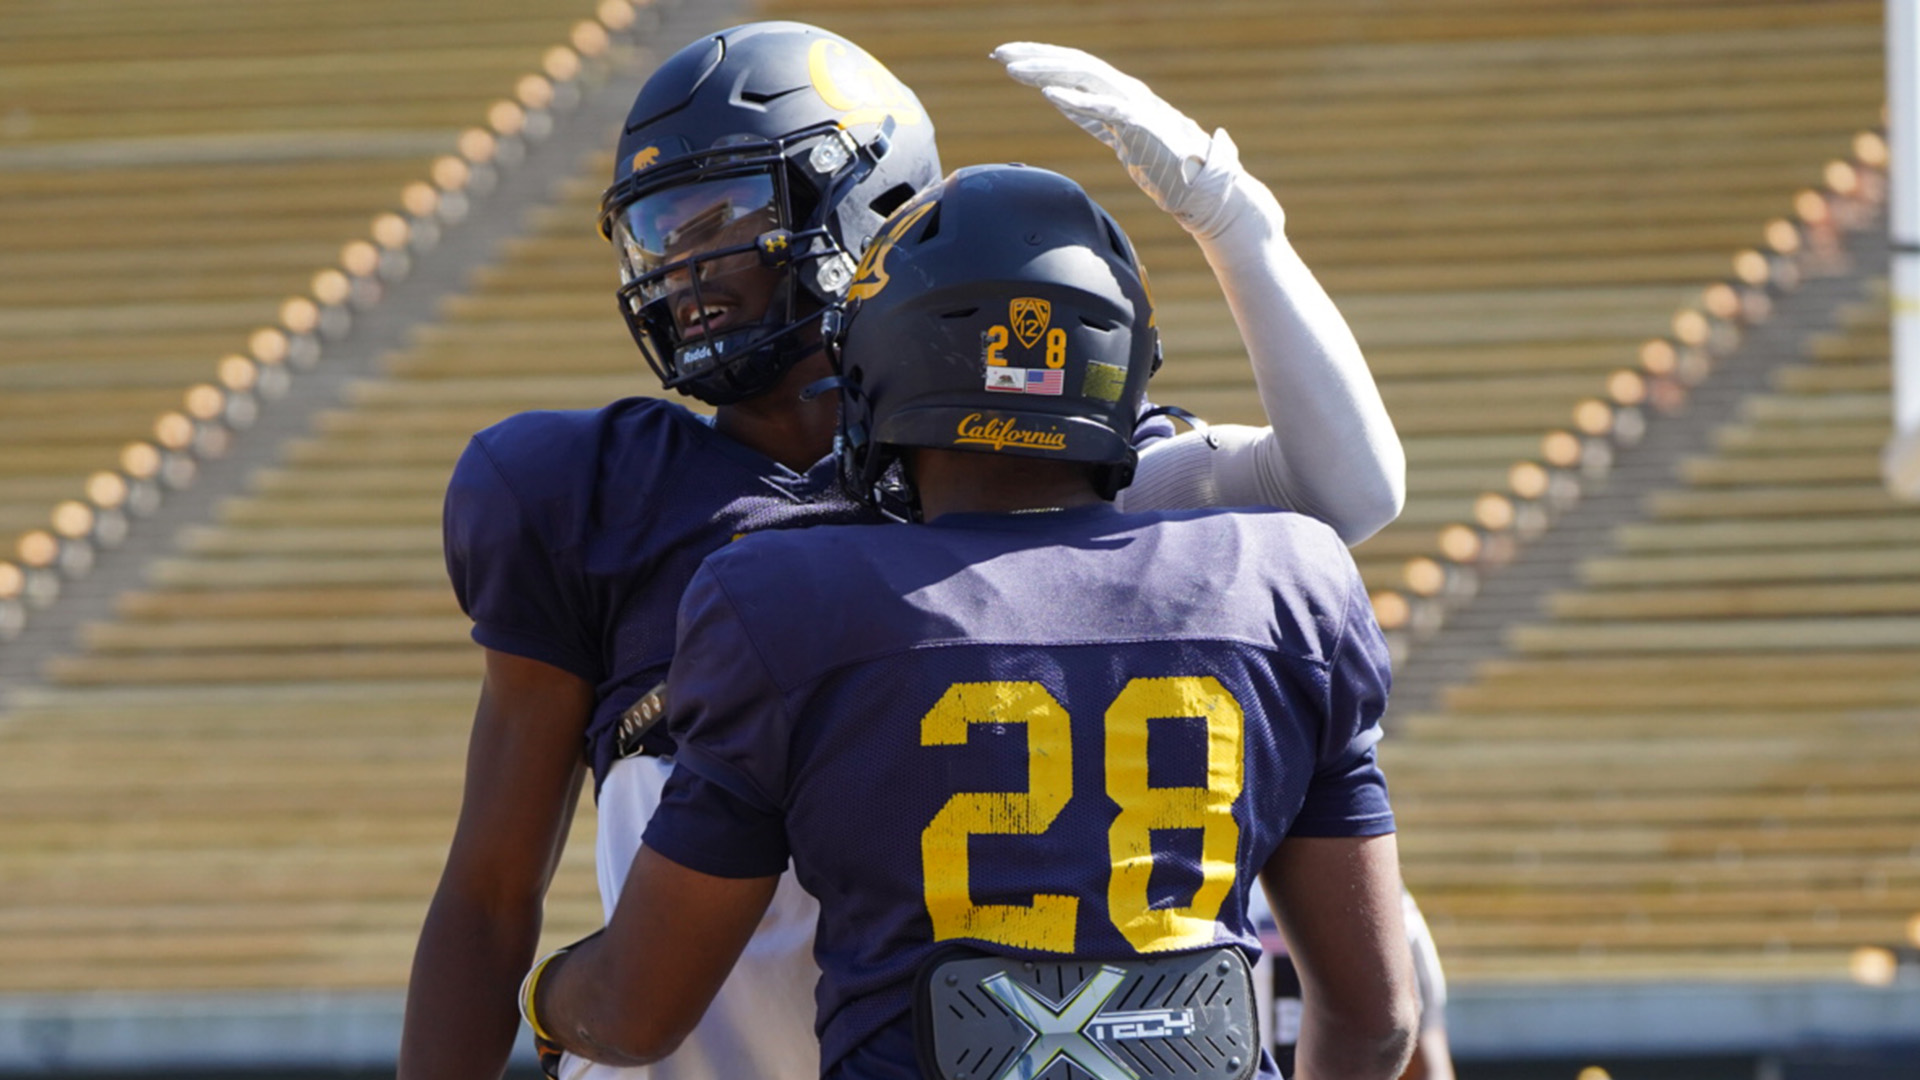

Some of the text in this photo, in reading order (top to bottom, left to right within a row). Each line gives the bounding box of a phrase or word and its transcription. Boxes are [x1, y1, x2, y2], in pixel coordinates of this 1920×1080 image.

[1013, 300, 1049, 326] PAC
[1020, 319, 1039, 337] 12
[987, 324, 1067, 369] 2 8
[954, 412, 1067, 450] California
[920, 676, 1244, 954] 28
